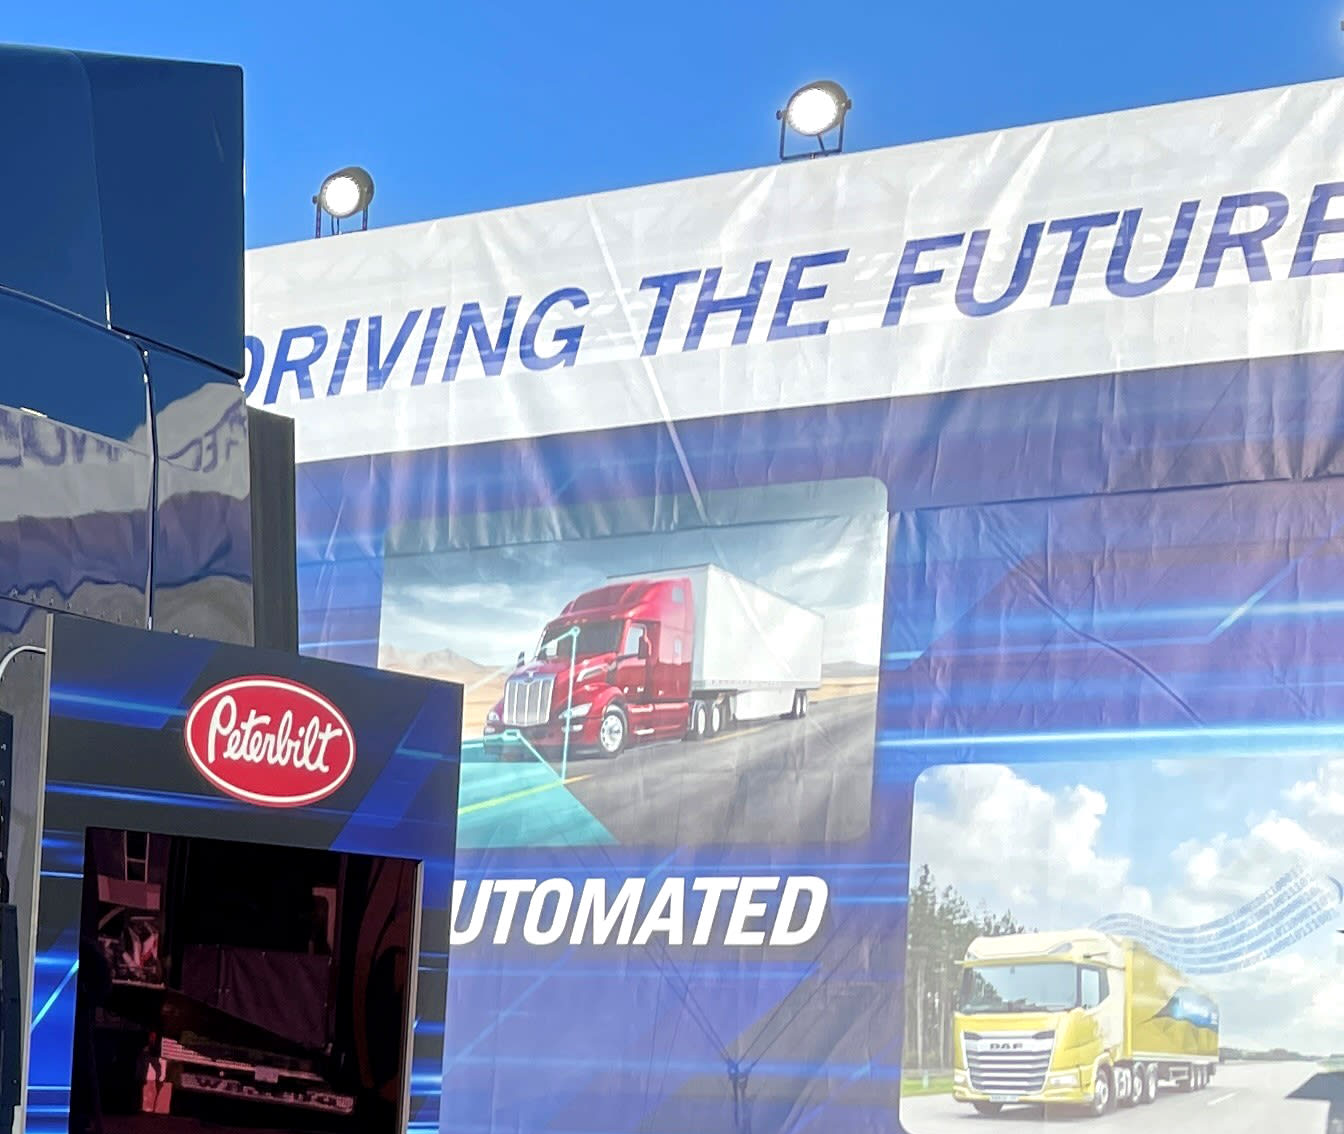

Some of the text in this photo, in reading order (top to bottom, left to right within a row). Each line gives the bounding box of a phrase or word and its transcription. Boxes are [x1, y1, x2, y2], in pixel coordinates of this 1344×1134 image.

[639, 247, 850, 358] THE
[207, 695, 343, 773] Peterbilt
[449, 875, 829, 947] UTOMATED
